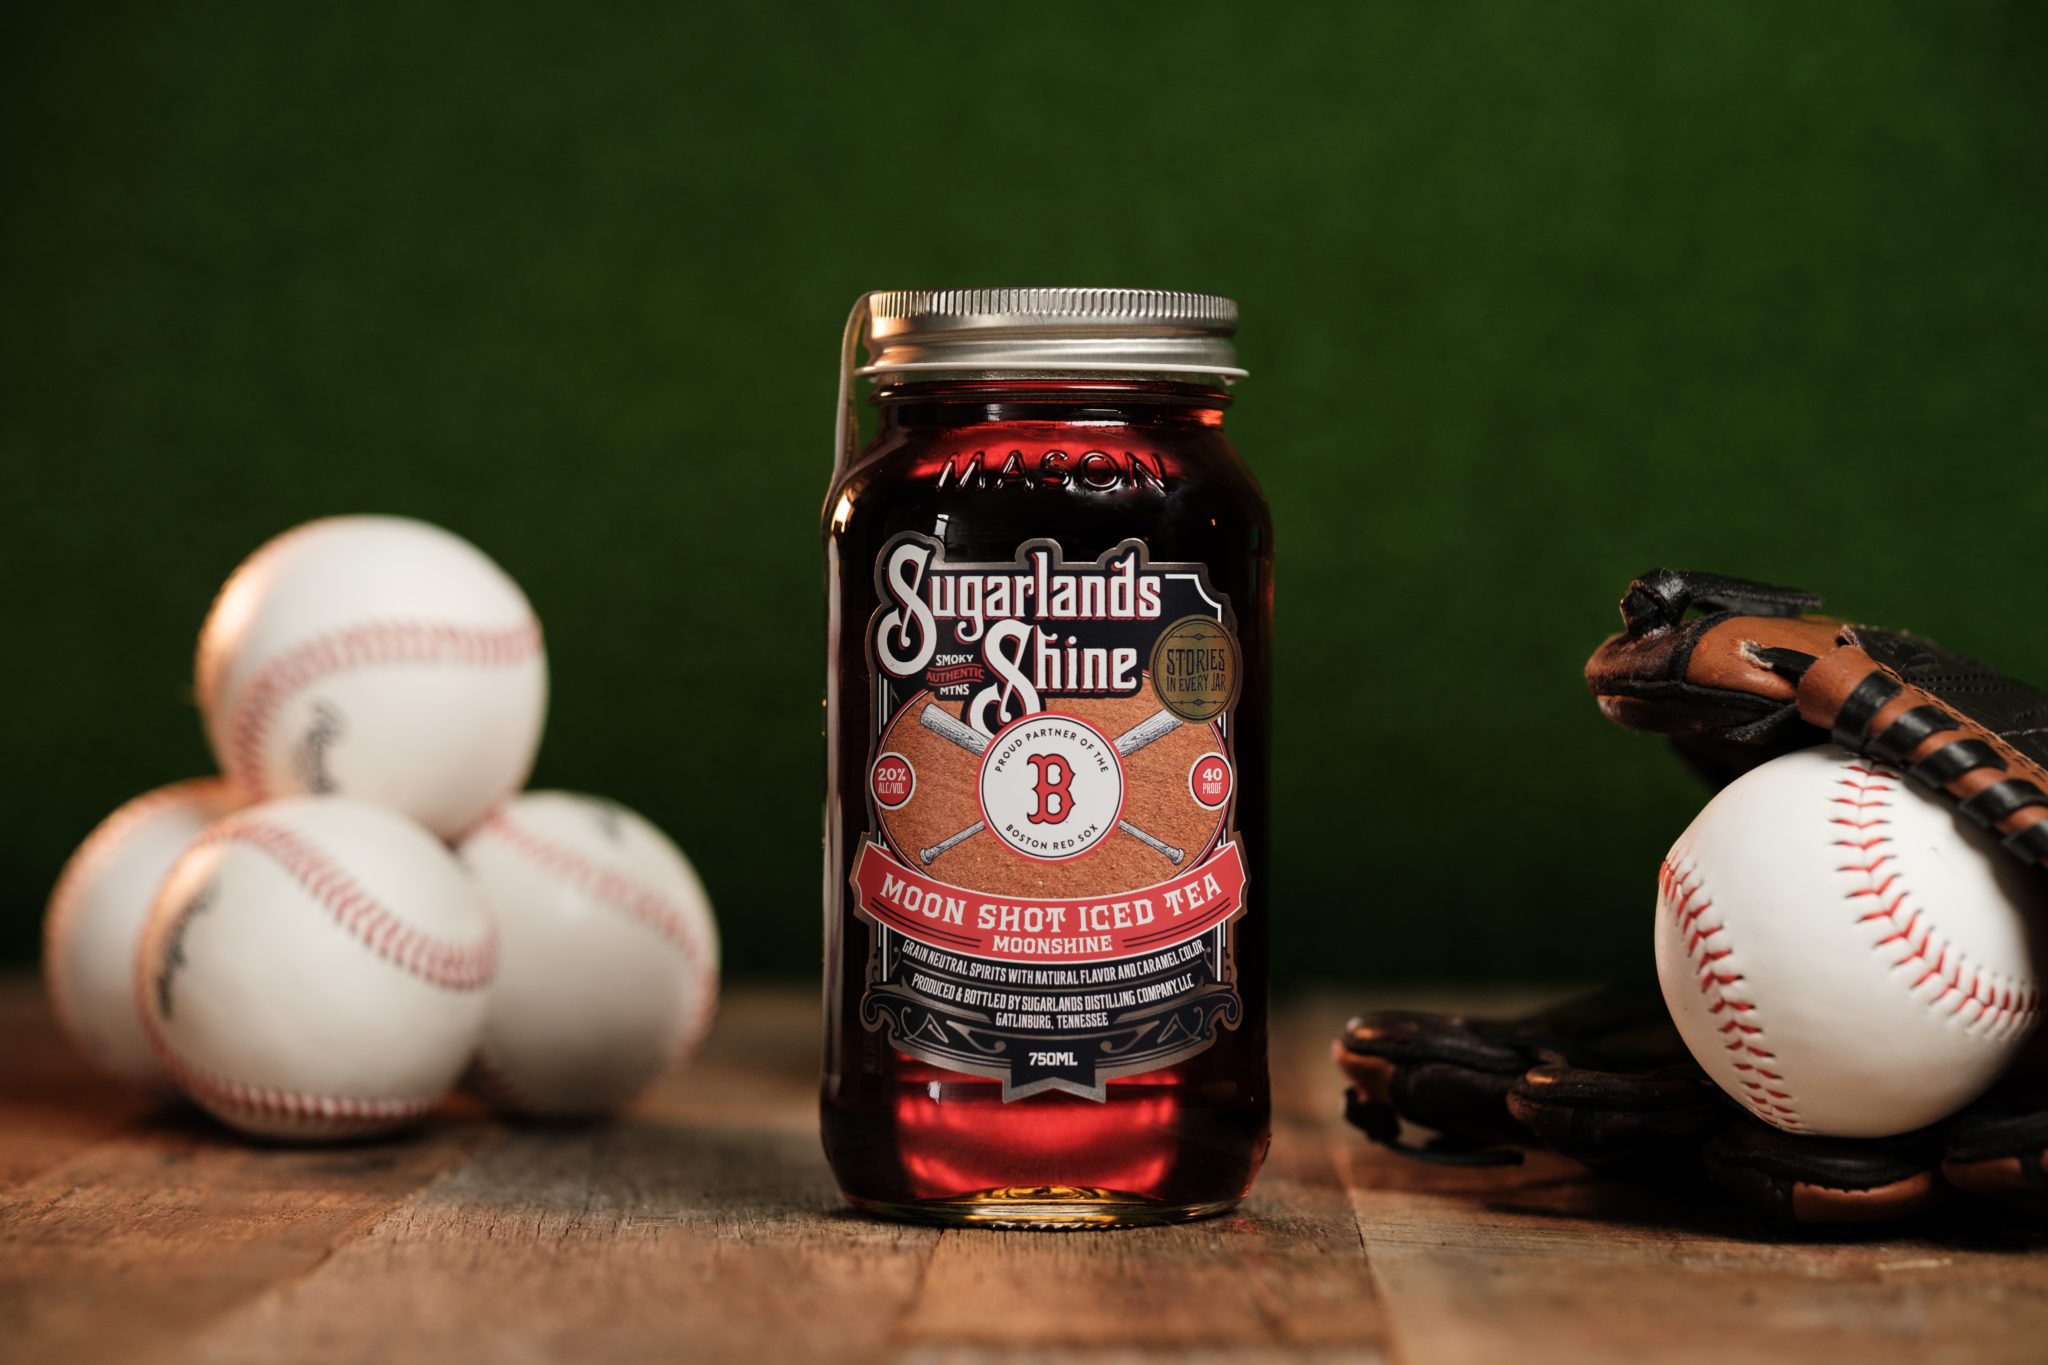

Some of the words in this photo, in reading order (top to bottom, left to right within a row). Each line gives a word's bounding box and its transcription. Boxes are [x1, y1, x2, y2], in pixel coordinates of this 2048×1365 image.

[936, 449, 1168, 496] MASON
[877, 543, 1162, 676] Sugarlands
[935, 654, 974, 666] SMOKY
[1166, 649, 1225, 676] STORIES
[926, 667, 985, 682] AUTHENTIC
[969, 619, 1138, 736] Shine
[1166, 675, 1176, 691] IN
[1179, 673, 1209, 691] EVERY
[1211, 672, 1226, 691] JAR
[940, 684, 970, 695] MTNS
[994, 739, 1023, 772] PROUD
[1026, 728, 1077, 741] PARTNER
[1080, 738, 1094, 751] OF
[1093, 752, 1109, 773] THE
[878, 768, 906, 781] 20%
[1202, 768, 1223, 781] 40
[878, 782, 904, 794] ALC/VOL
[1026, 753, 1076, 825] B
[1202, 782, 1222, 794] PROOF
[1005, 824, 1047, 850] BOSTON
[1053, 839, 1075, 850] RED
[1079, 824, 1099, 842] SOX
[879, 872, 967, 926] MOON
[977, 904, 1066, 933] SHOT
[1078, 898, 1155, 932] ICED
[1163, 872, 1222, 917] TEA
[992, 935, 1114, 955] MOONSHINE
[902, 939, 929, 962] GRAIN
[927, 950, 968, 976] NEUTRAL
[969, 962, 1006, 982] SPIRITS
[1008, 968, 1034, 985] WITH
[1035, 970, 1081, 985] NATURAL
[1080, 966, 1117, 984] FLAVOR
[1118, 962, 1137, 980] AND
[1137, 951, 1180, 976] CARAMEL
[1178, 939, 1205, 962] COLOR
[911, 973, 956, 1000] PRODUCED
[955, 987, 962, 1001] &
[963, 988, 1006, 1010] BOTTLED
[1008, 995, 1023, 1011] BY
[1022, 995, 1083, 1012] SUGARLANDS
[1084, 990, 1136, 1010] DISTILLING
[1056, 1012, 1109, 1030] TENNESSEE
[1028, 1052, 1078, 1066] 750ML
